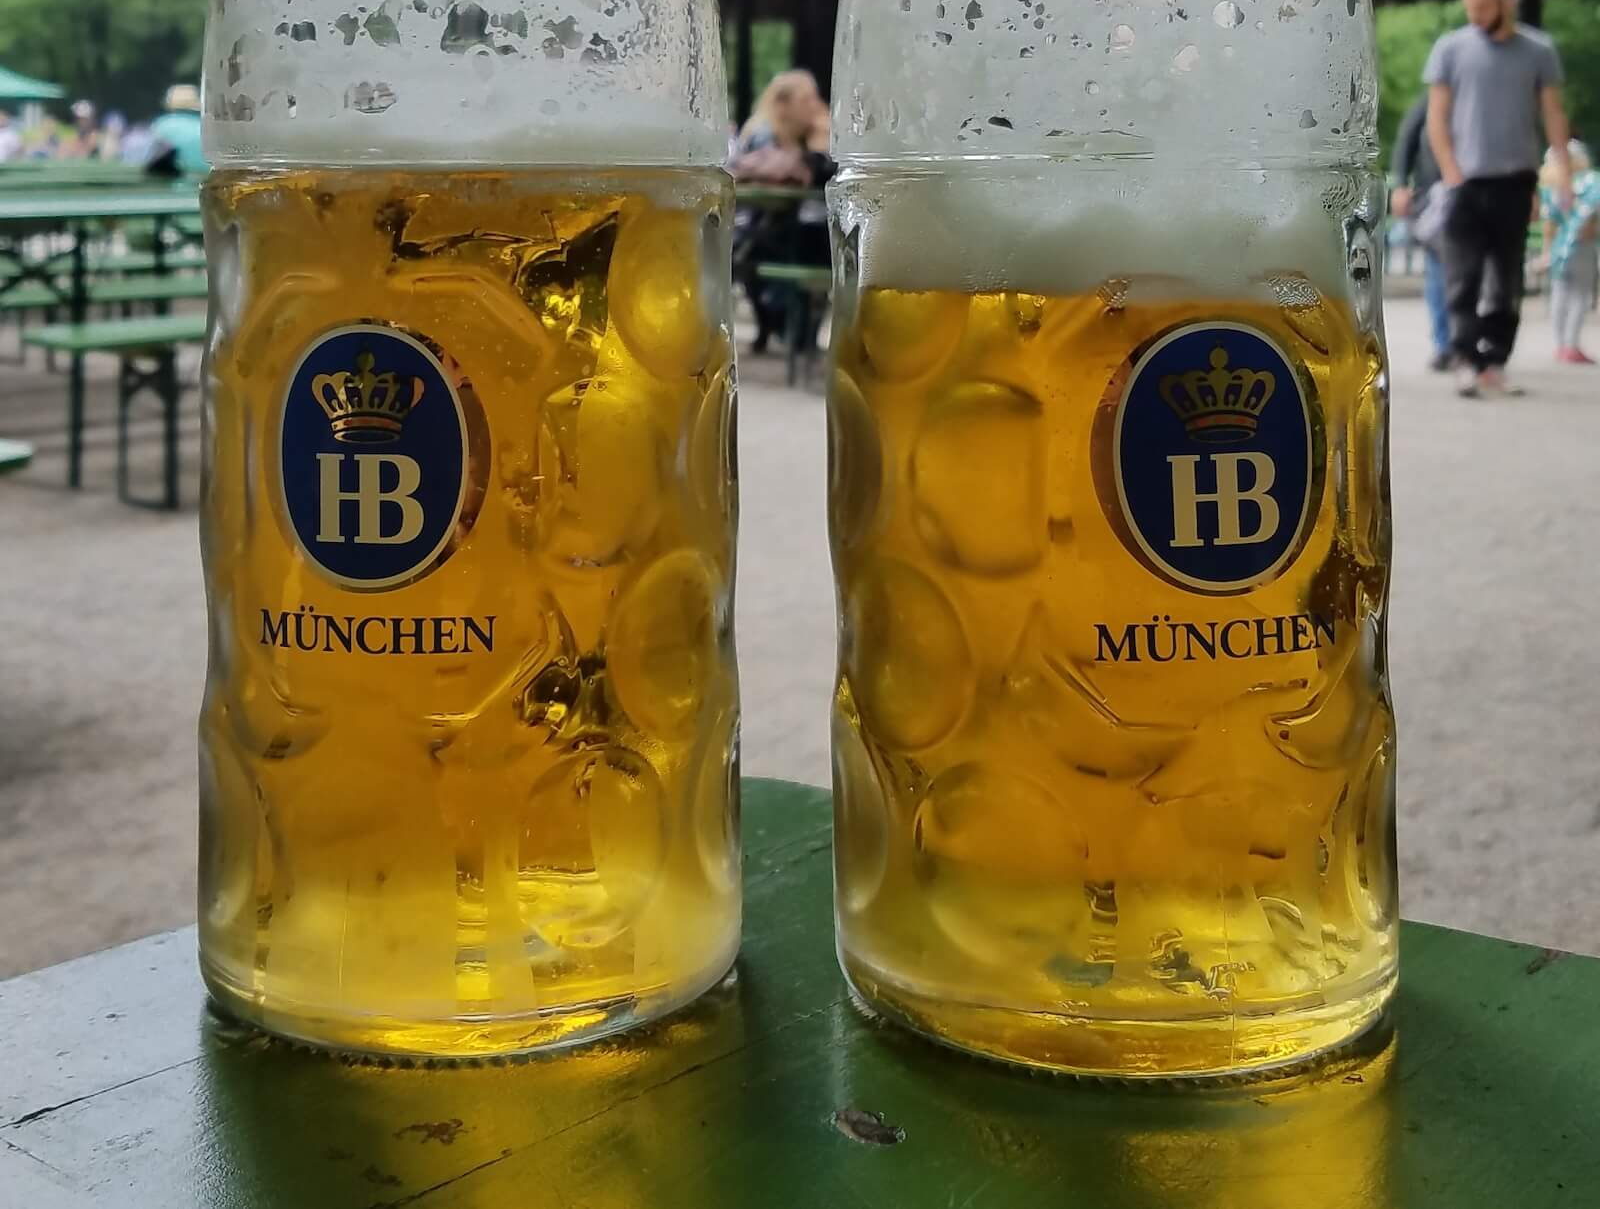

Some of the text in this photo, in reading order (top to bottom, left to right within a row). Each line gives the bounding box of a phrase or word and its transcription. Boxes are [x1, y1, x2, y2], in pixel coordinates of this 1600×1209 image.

[316, 453, 425, 544] HB
[1166, 451, 1280, 547] HB
[260, 605, 497, 655] MÜNCHEN
[1093, 614, 1337, 663] MÜNCHEN
